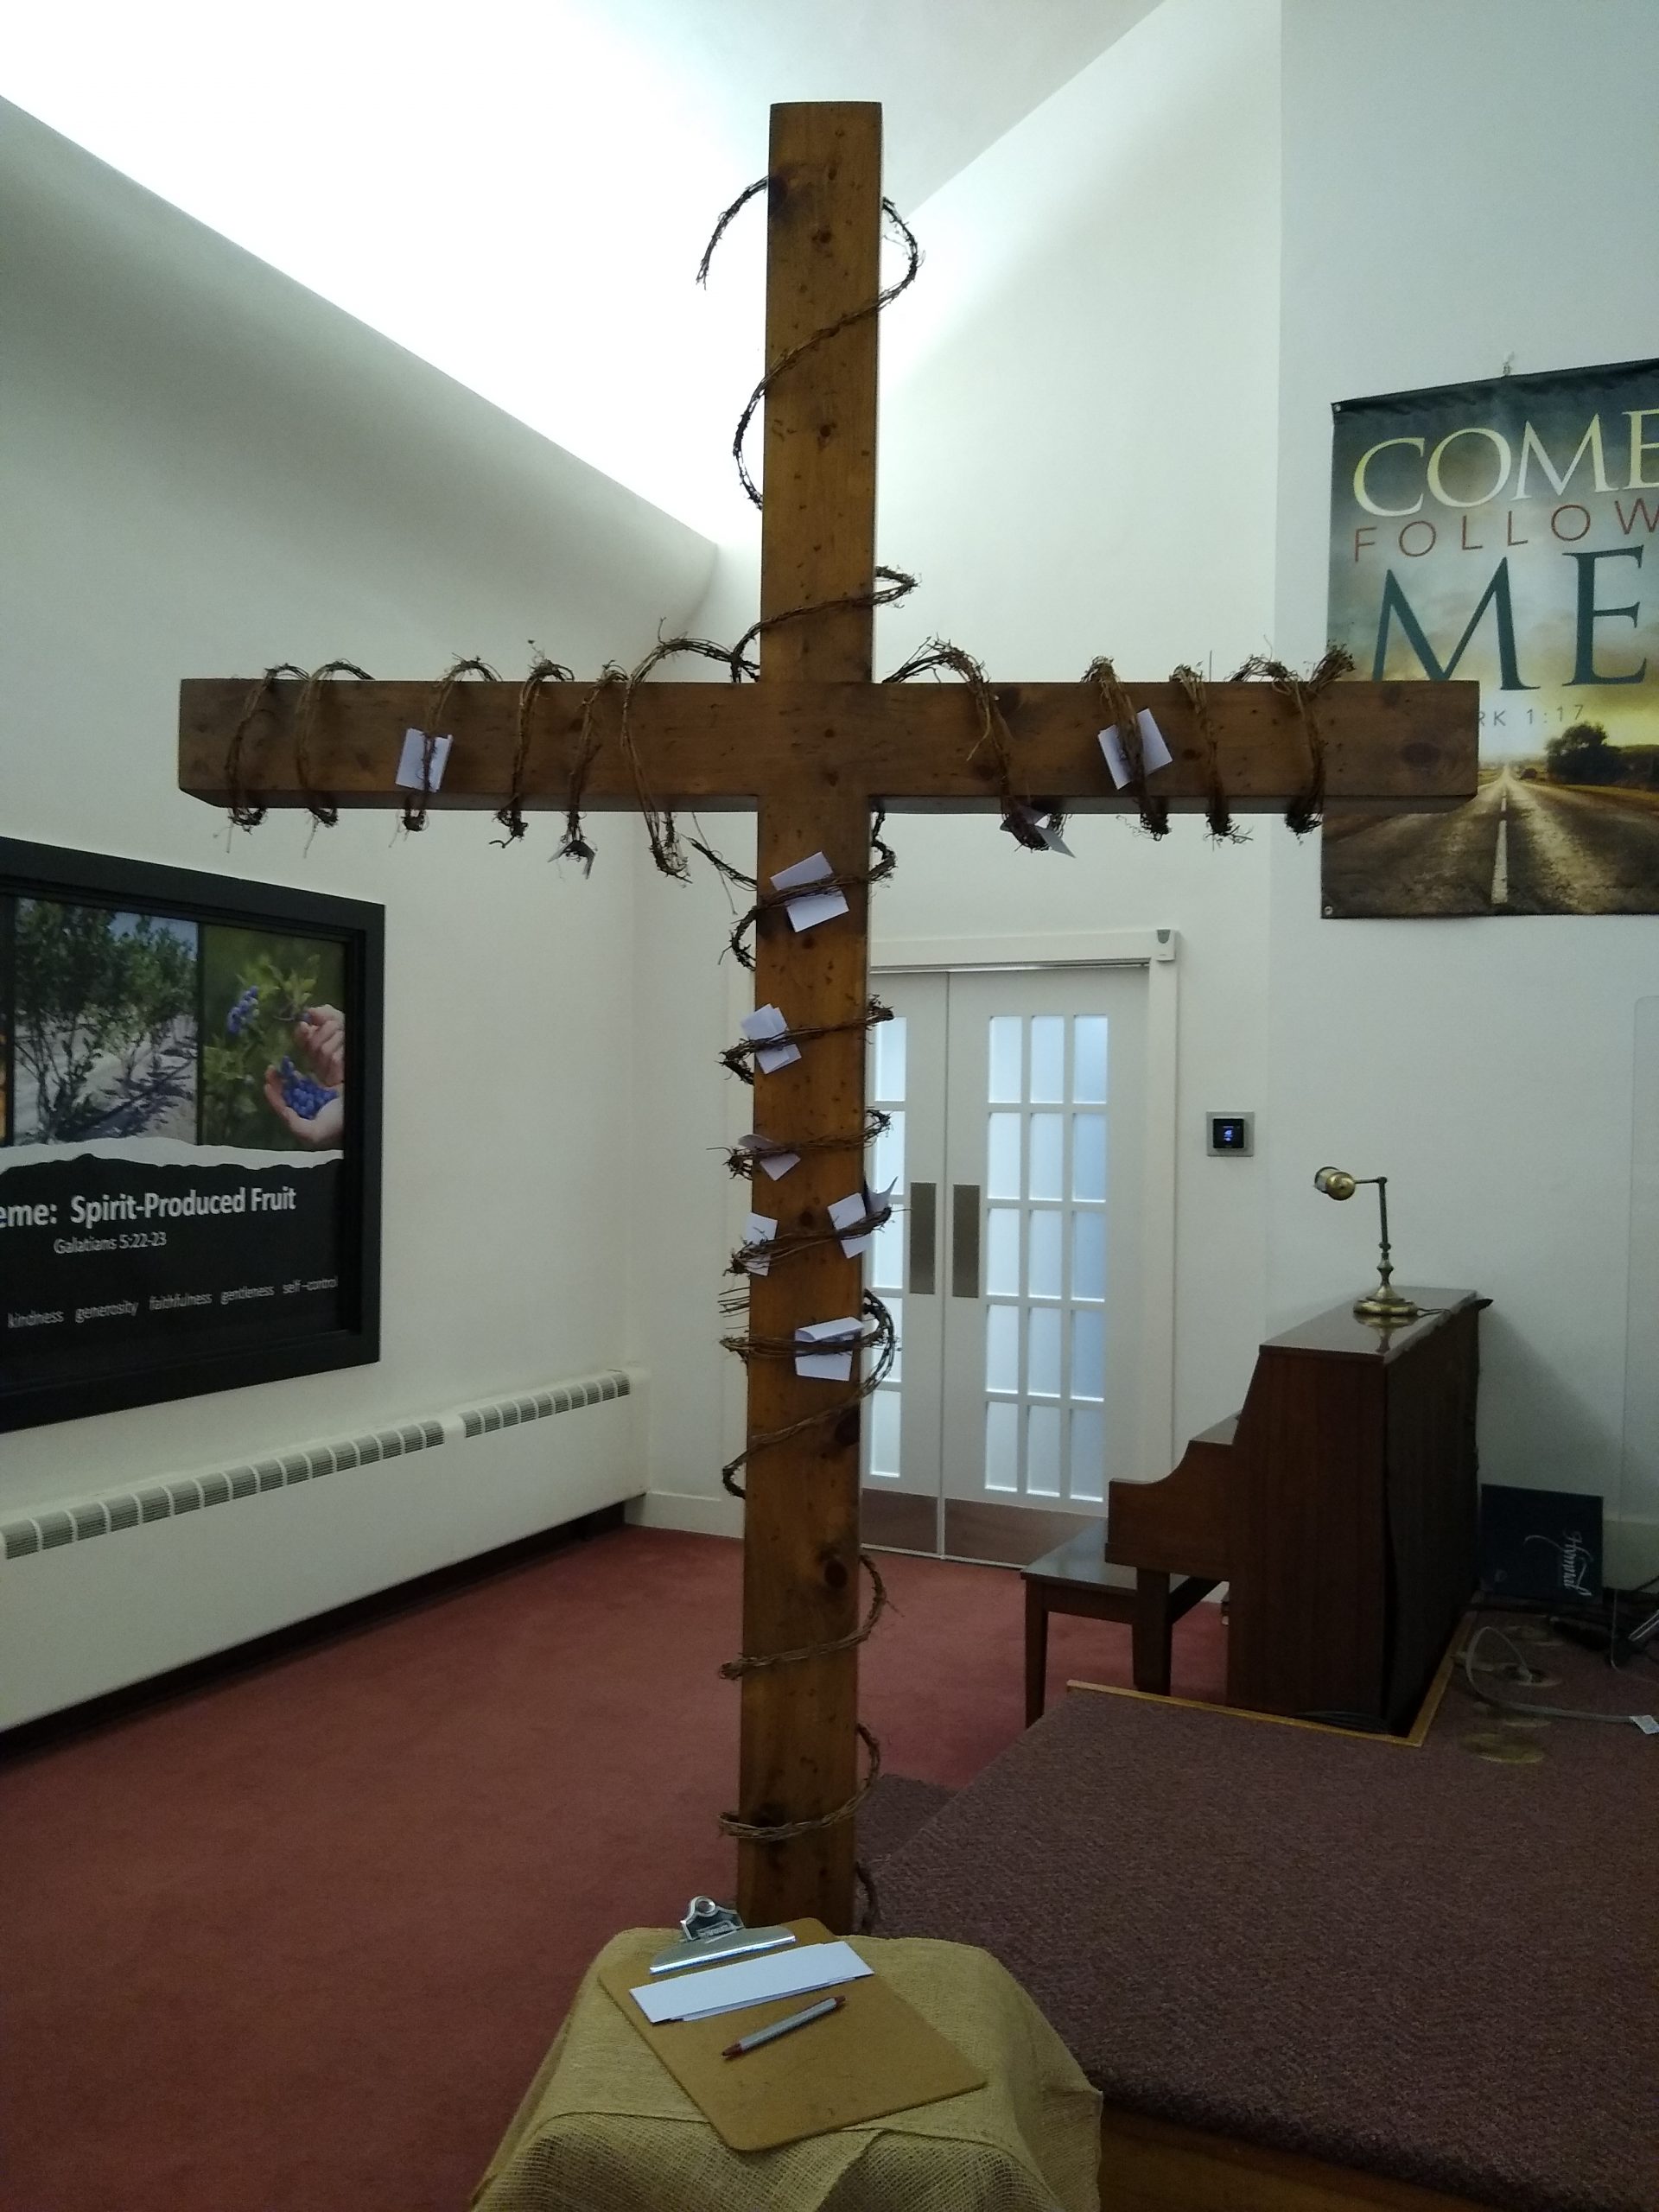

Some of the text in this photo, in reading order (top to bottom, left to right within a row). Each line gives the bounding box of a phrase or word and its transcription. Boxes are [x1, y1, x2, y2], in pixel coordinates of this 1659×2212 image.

[1354, 409, 1659, 516] COME
[1355, 497, 1659, 563] FOLLOW
[1372, 544, 1647, 690] ME
[1478, 704, 1584, 727] RK 1:17
[70, 1186, 245, 1229] Spirit-Produced
[251, 1185, 296, 1211] Fruit
[54, 1231, 167, 1254] Galatians 5:22-23
[8, 1309, 64, 1328] kindness
[75, 1300, 138, 1323] generosity
[149, 1293, 213, 1311] faithfulness
[220, 1284, 275, 1305] gentleness
